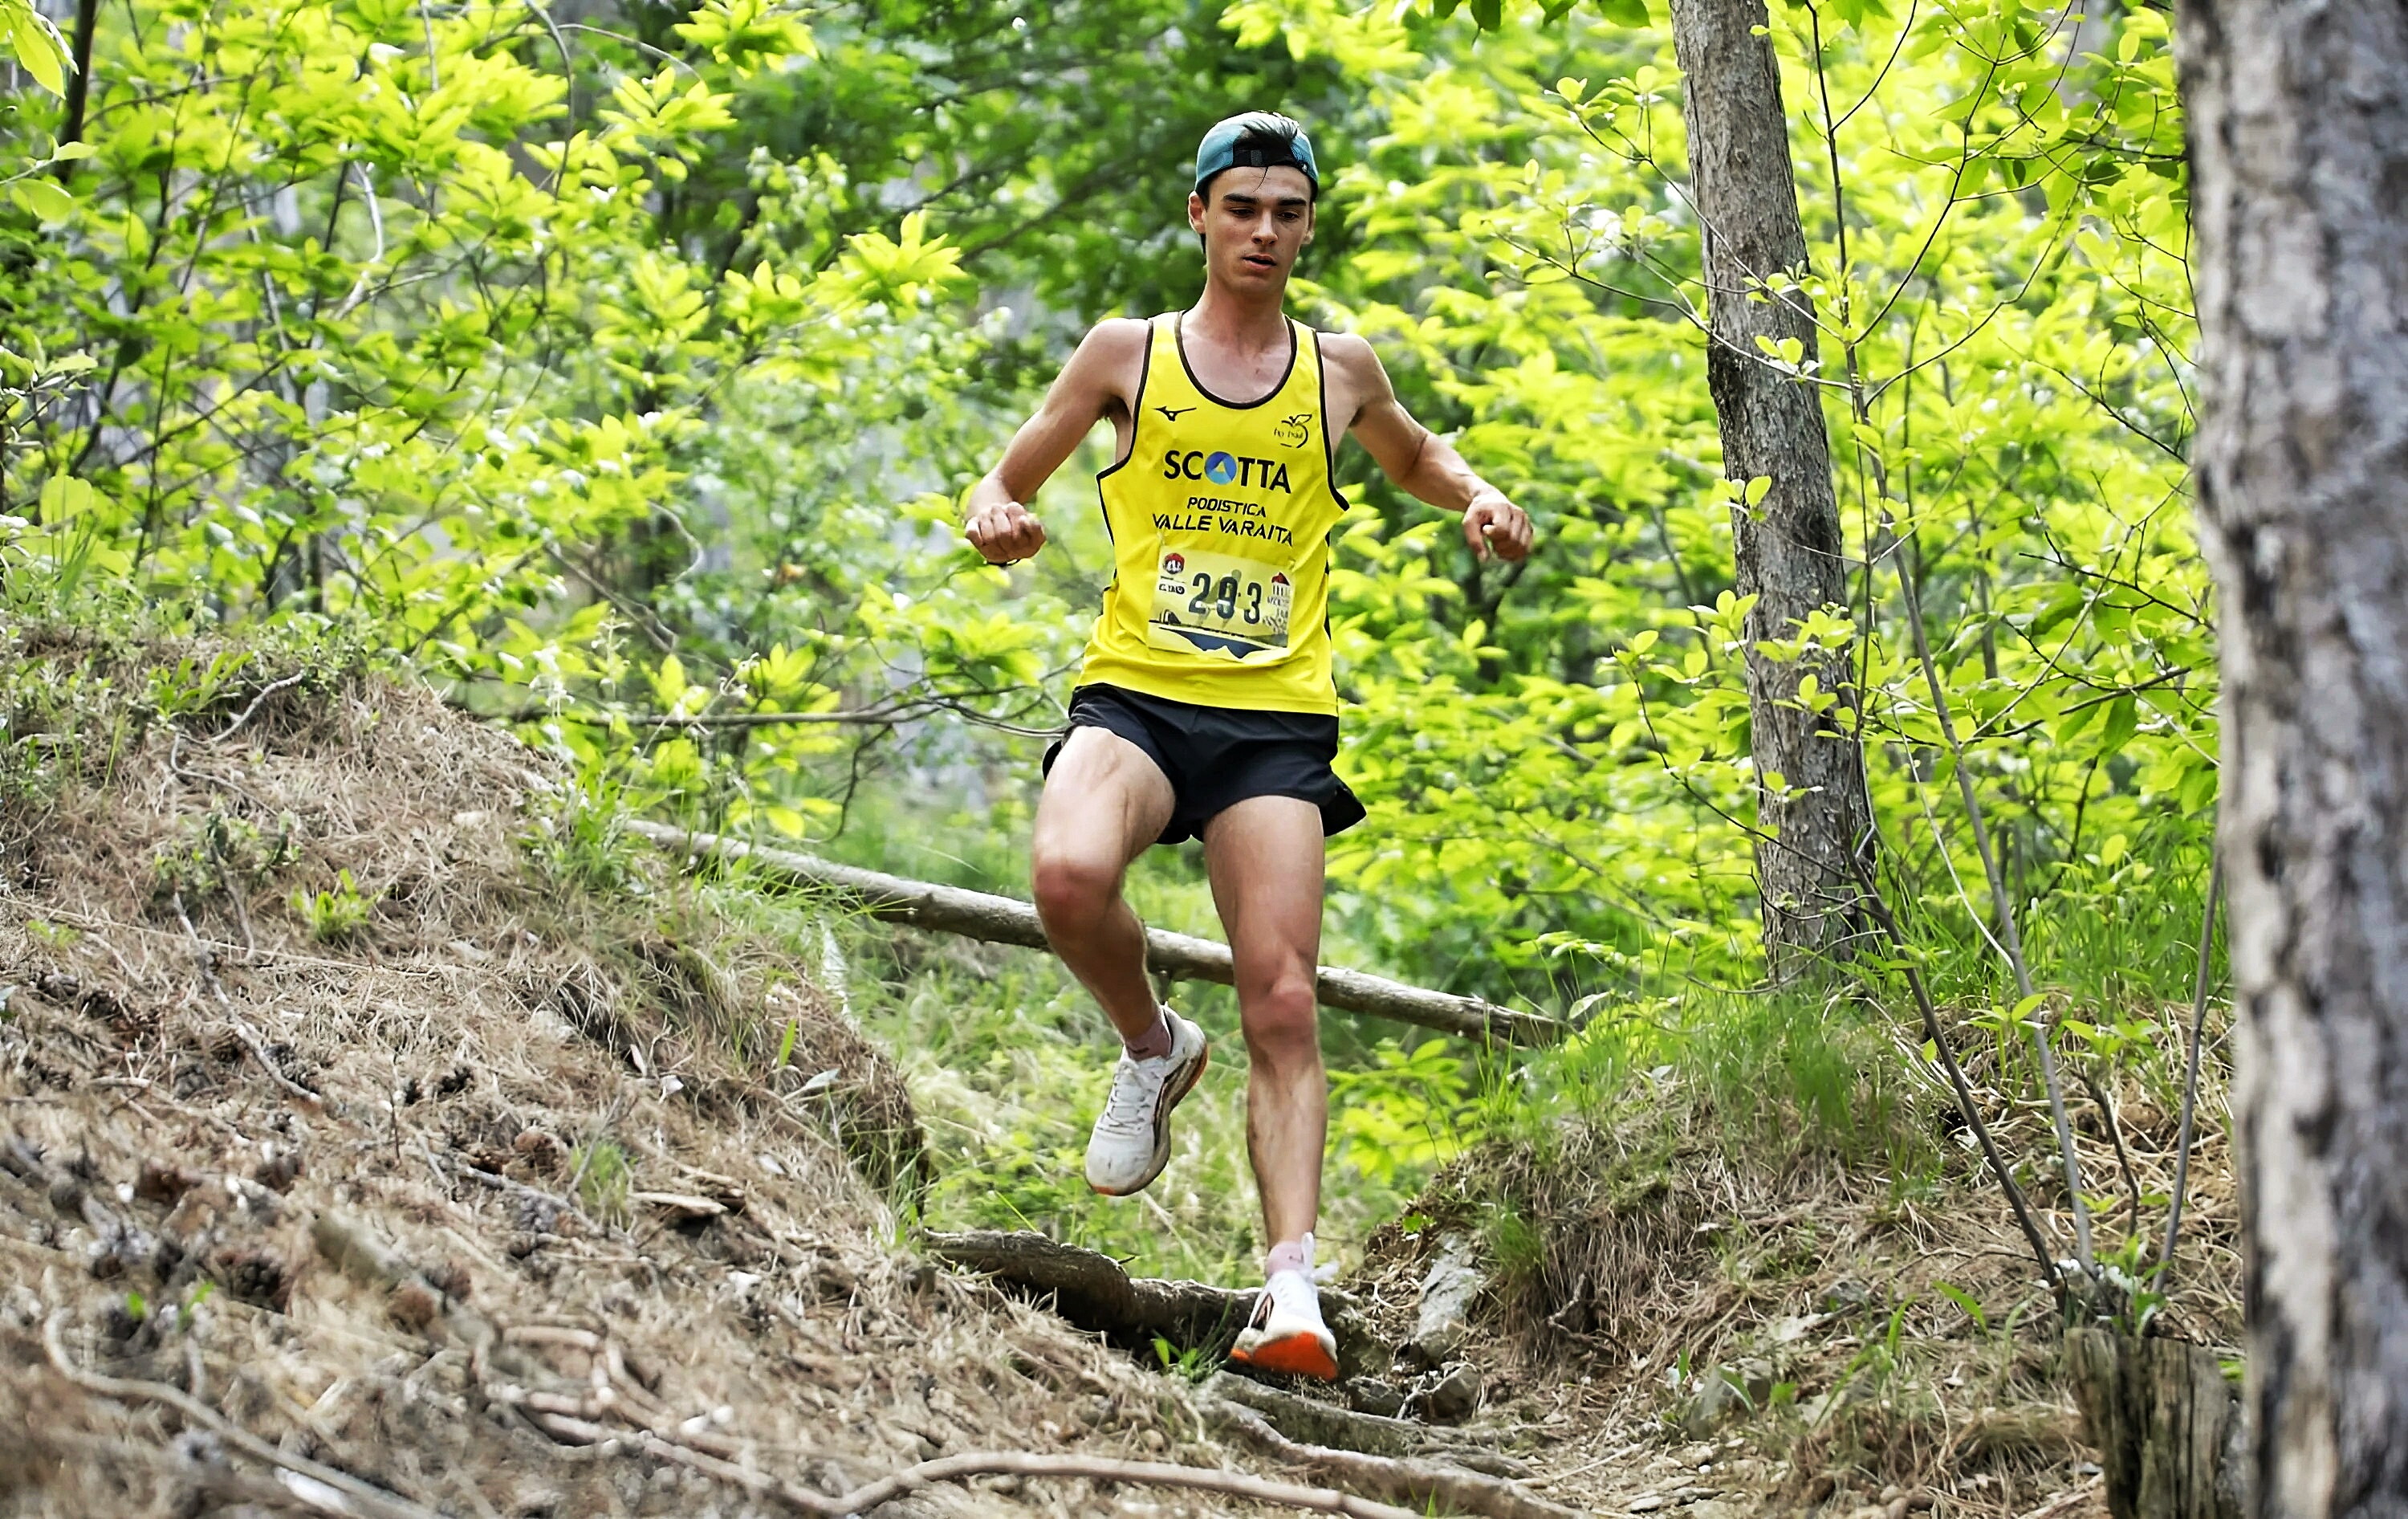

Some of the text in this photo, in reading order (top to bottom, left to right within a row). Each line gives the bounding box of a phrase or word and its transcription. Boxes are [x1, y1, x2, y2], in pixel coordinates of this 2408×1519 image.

[1164, 450, 1291, 494] SCOTTA
[1186, 497, 1266, 517] PODISTICA
[1152, 514, 1293, 547] VALLE VARAITA
[1189, 572, 1262, 624] 293
